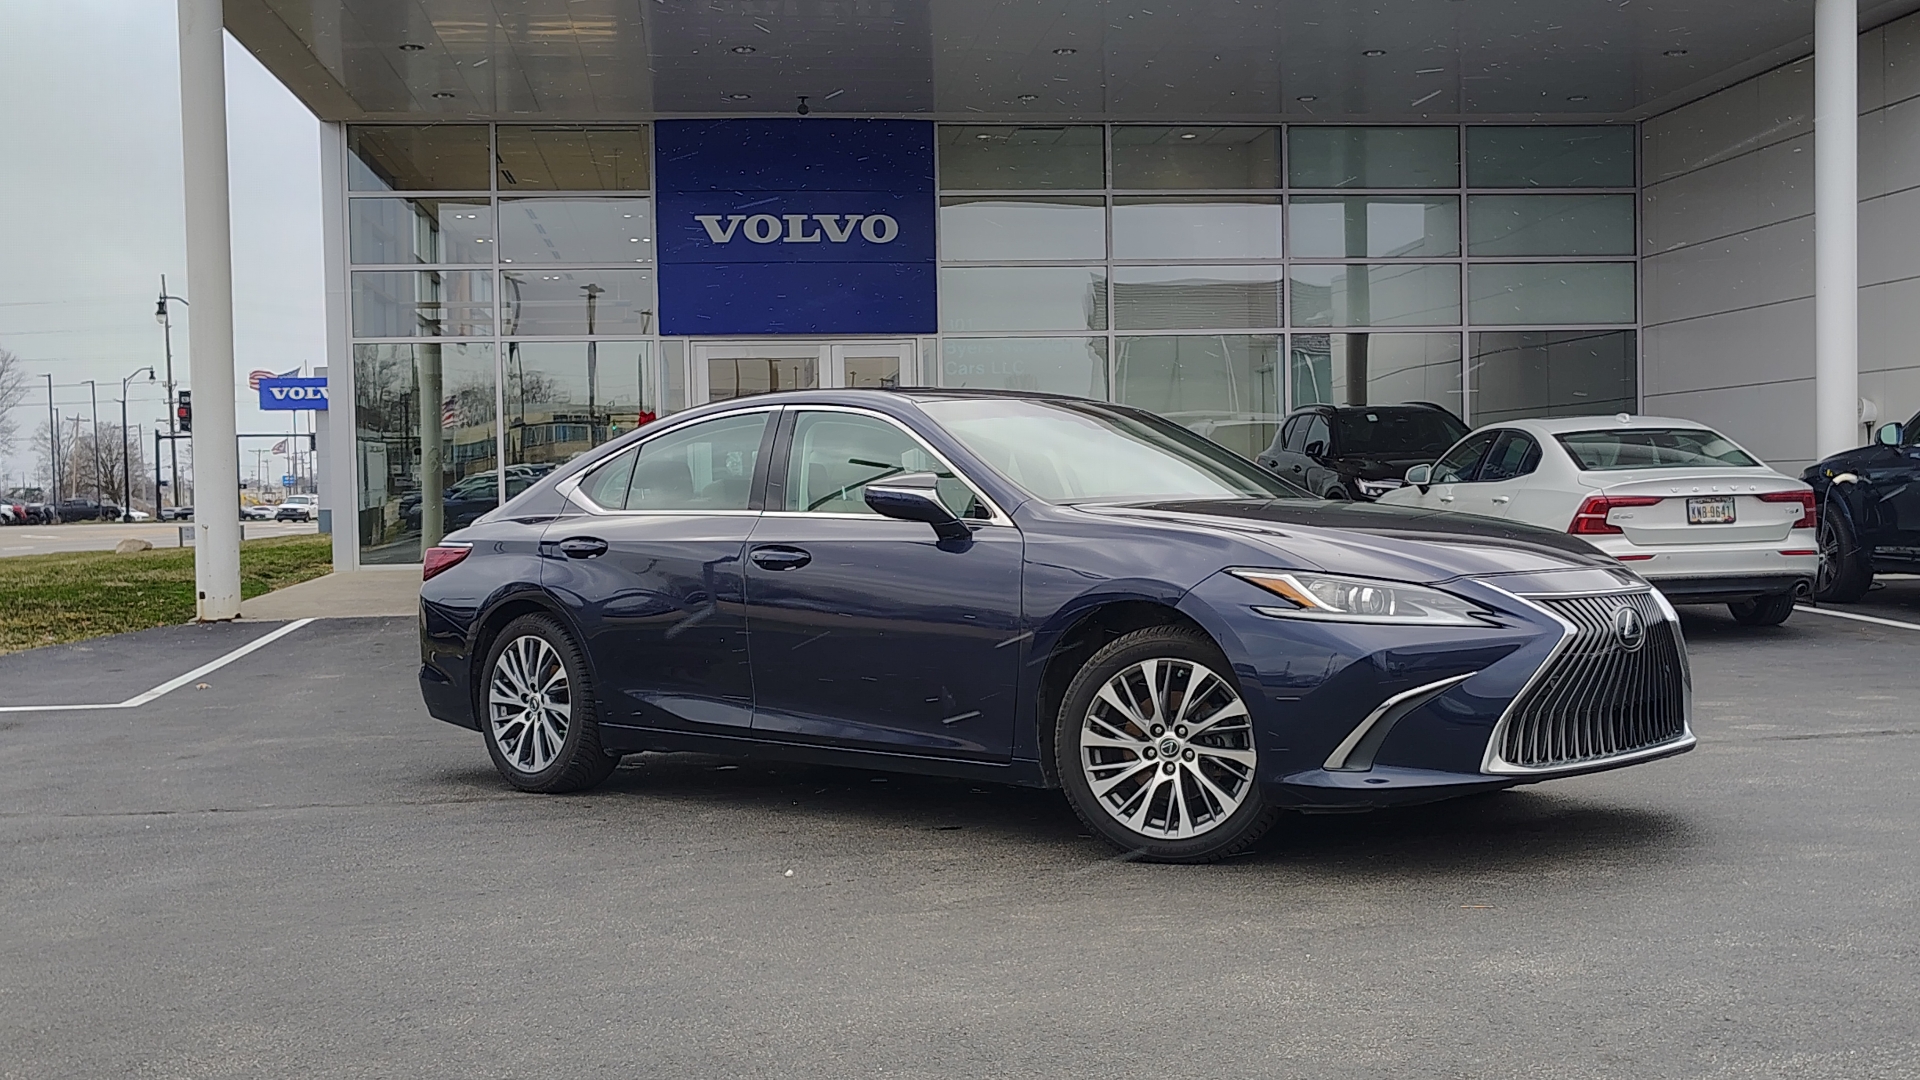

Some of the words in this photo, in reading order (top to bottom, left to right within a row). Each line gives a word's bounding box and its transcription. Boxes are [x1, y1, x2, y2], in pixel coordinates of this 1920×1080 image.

[694, 214, 899, 244] VOLVO
[945, 341, 994, 357] Byers
[945, 361, 985, 375] Cars
[991, 360, 1025, 375] LLC
[269, 387, 329, 400] VOLV
[1670, 485, 1757, 493] VOLVO
